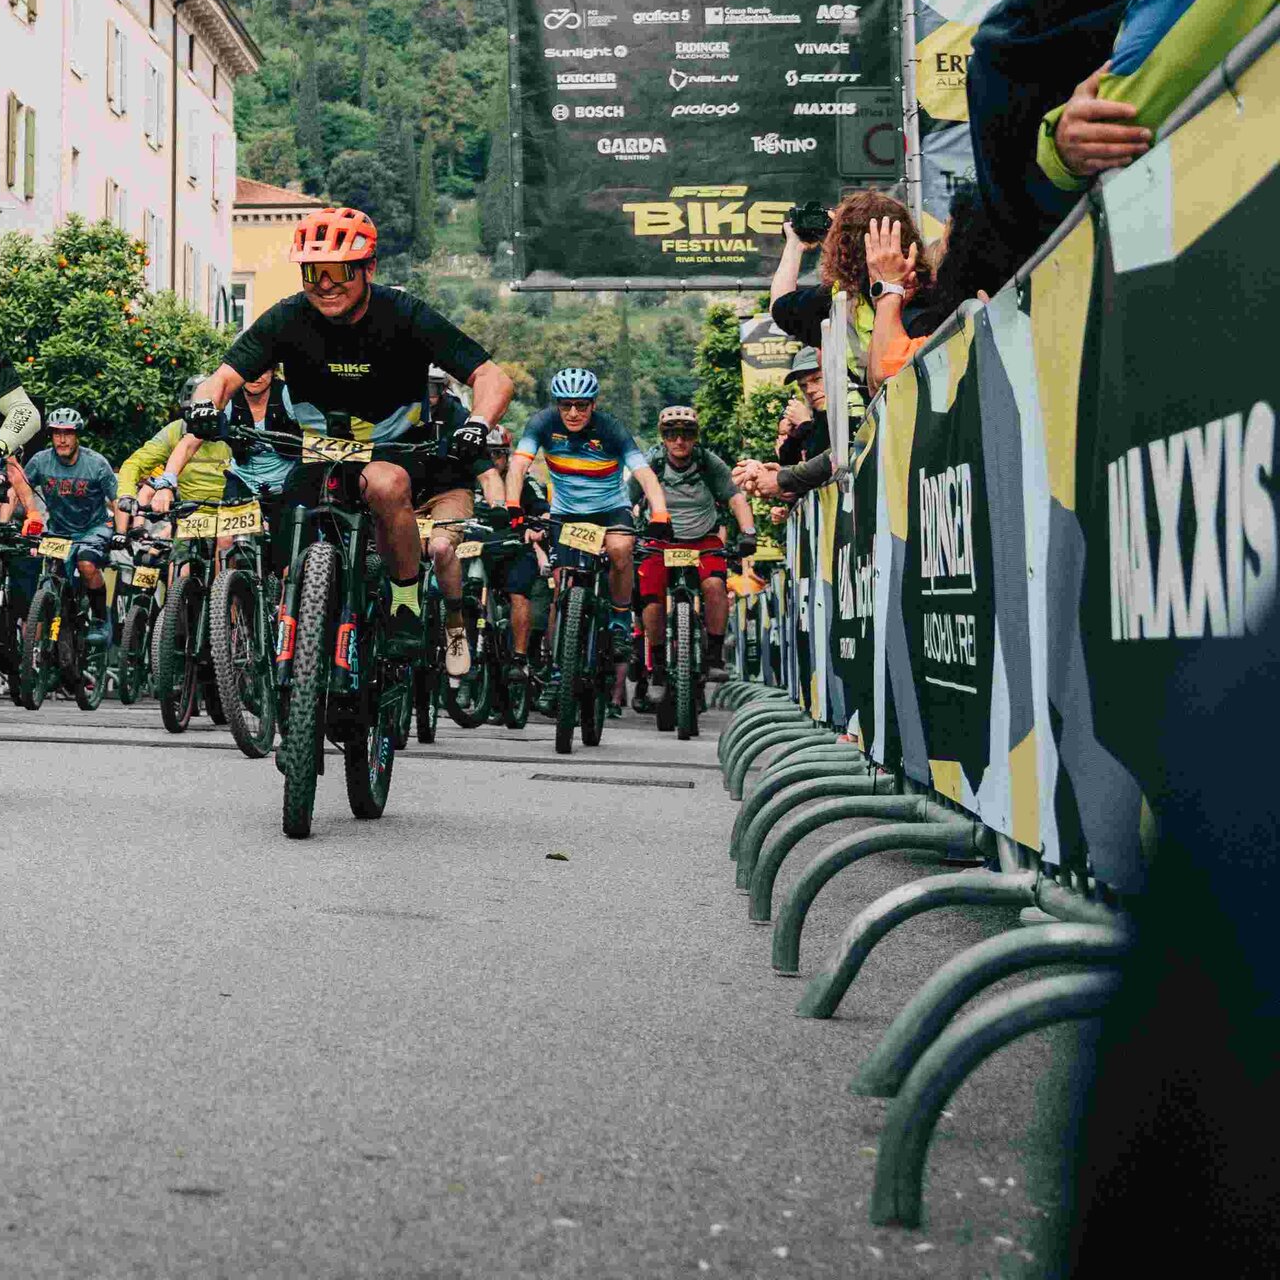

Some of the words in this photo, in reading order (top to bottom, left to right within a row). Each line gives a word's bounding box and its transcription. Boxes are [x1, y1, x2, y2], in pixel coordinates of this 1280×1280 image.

[680, 8, 691, 21] 5
[816, 4, 861, 20] AGS
[544, 46, 613, 59] Sunlight
[675, 41, 730, 54] ERDINGER
[798, 73, 862, 83] SCOTT
[574, 105, 625, 118] BOSCH
[793, 102, 858, 115] MAXXIS
[597, 137, 667, 154] GARDA
[750, 132, 818, 155] TRENTINO
[622, 201, 797, 236] BIKE
[661, 239, 759, 252] FESTIVAL
[715, 255, 746, 263] GARDA
[328, 363, 371, 373] BIKE
[223, 514, 256, 531] 2263
[1108, 401, 1278, 641] MAXXIS
[569, 524, 597, 542] 2226
